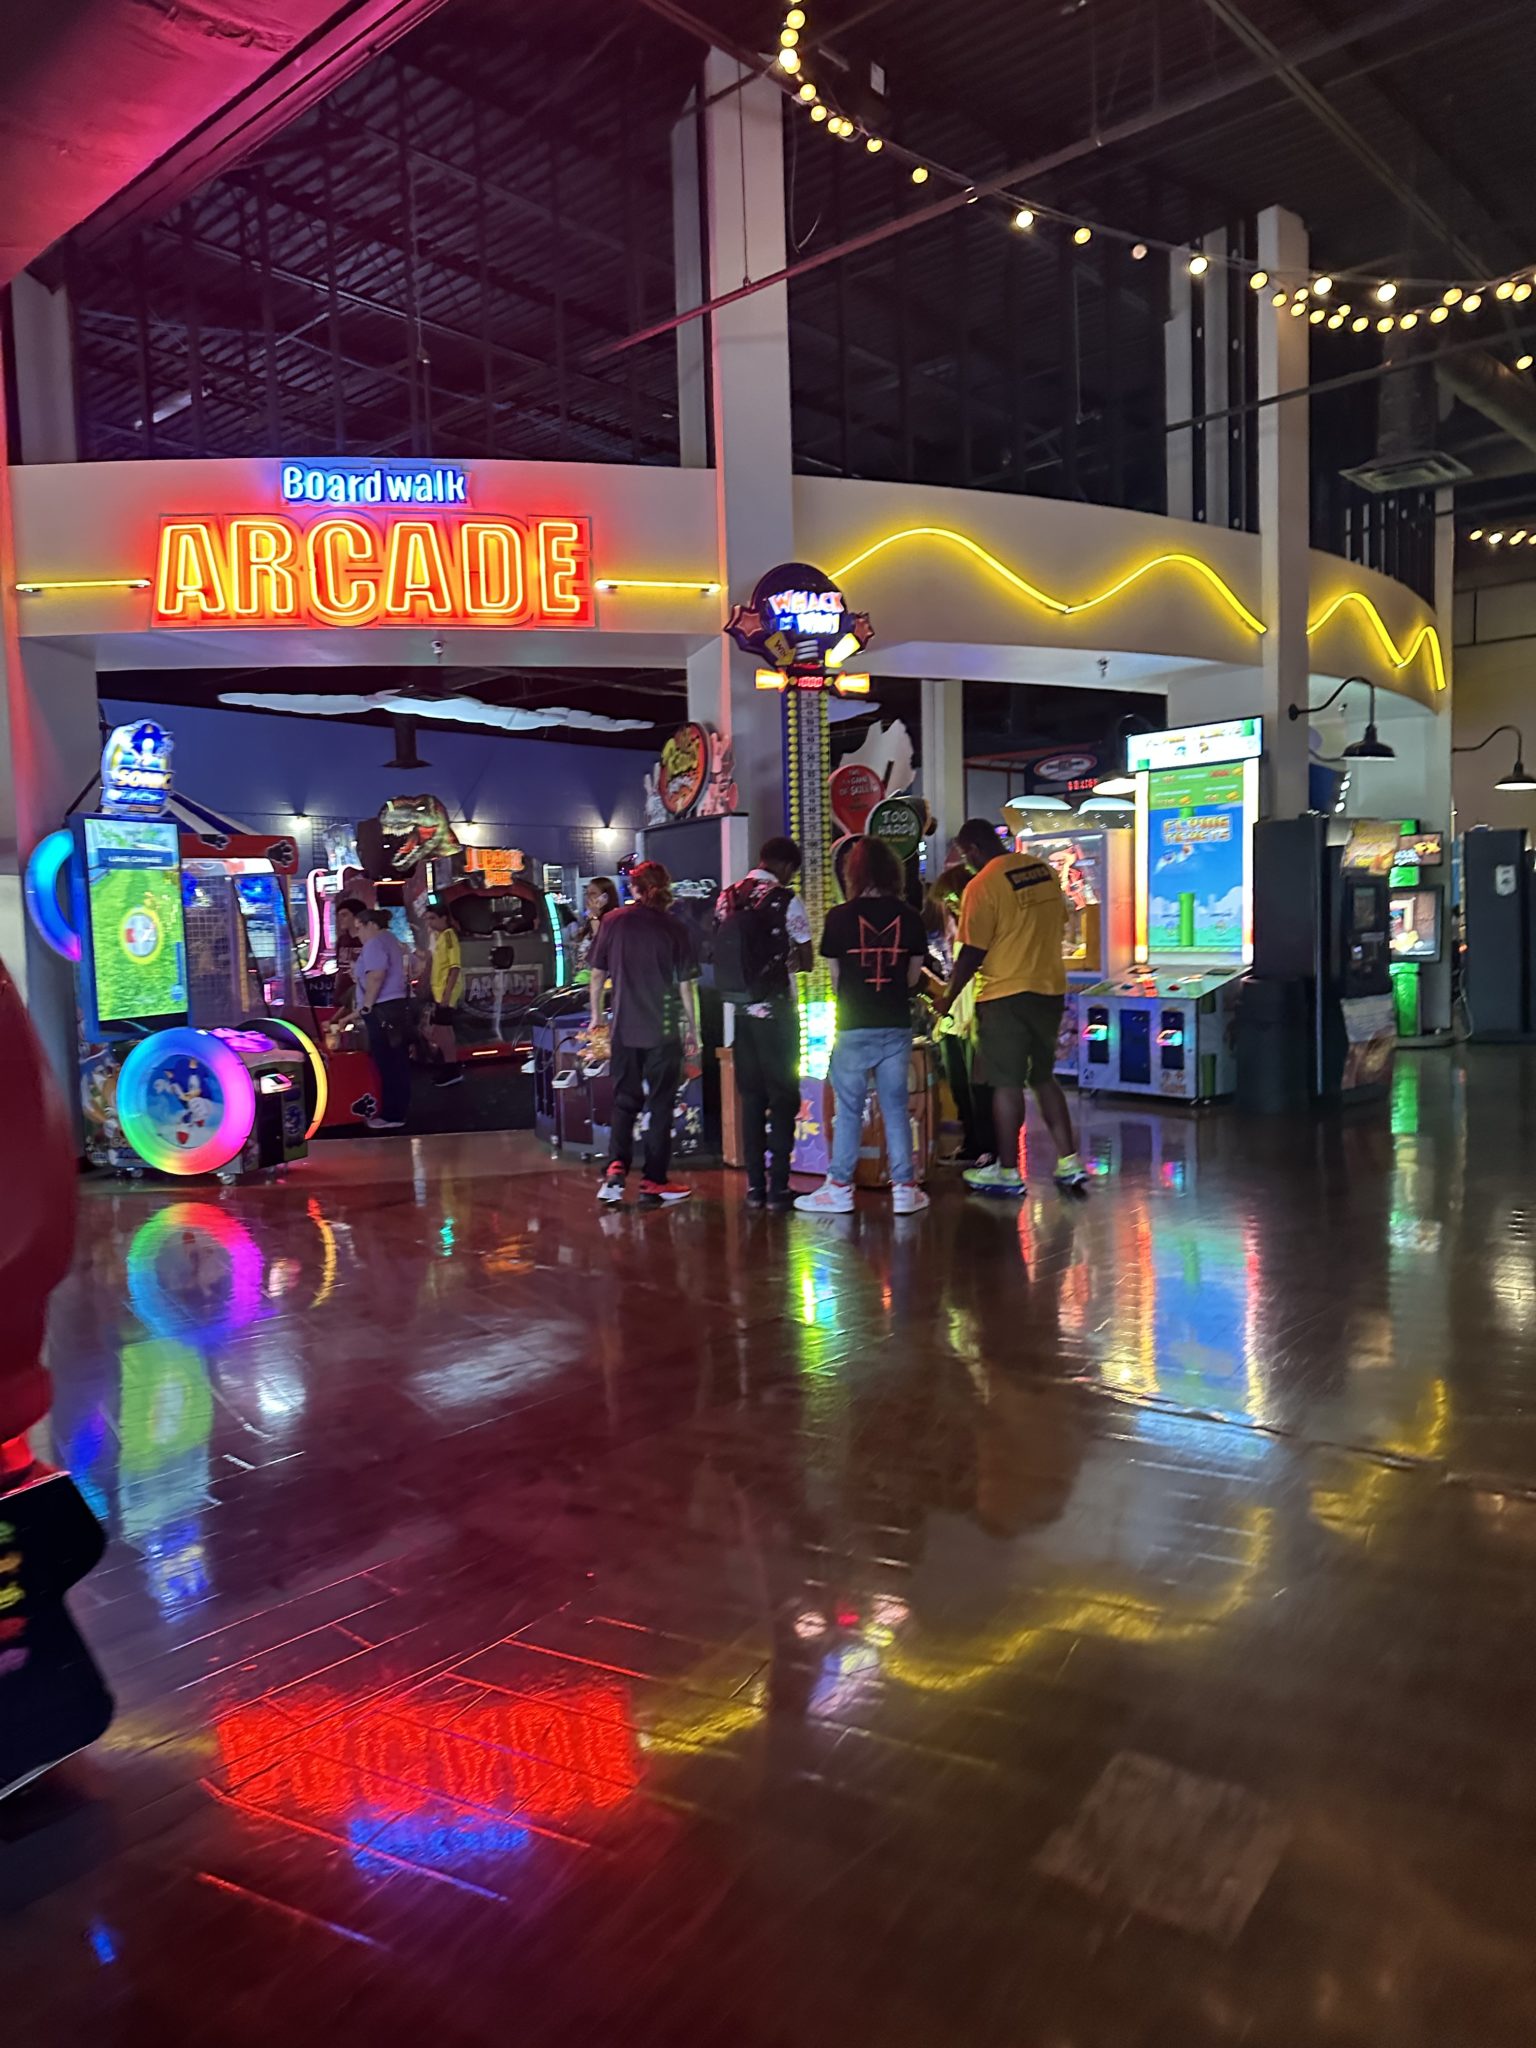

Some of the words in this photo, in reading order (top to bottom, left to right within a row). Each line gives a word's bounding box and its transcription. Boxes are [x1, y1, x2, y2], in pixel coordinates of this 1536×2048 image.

[282, 465, 467, 503] Boardwalk
[155, 516, 586, 622] ARCADE
[768, 589, 844, 615] WHACK
[881, 809, 909, 824] TOO
